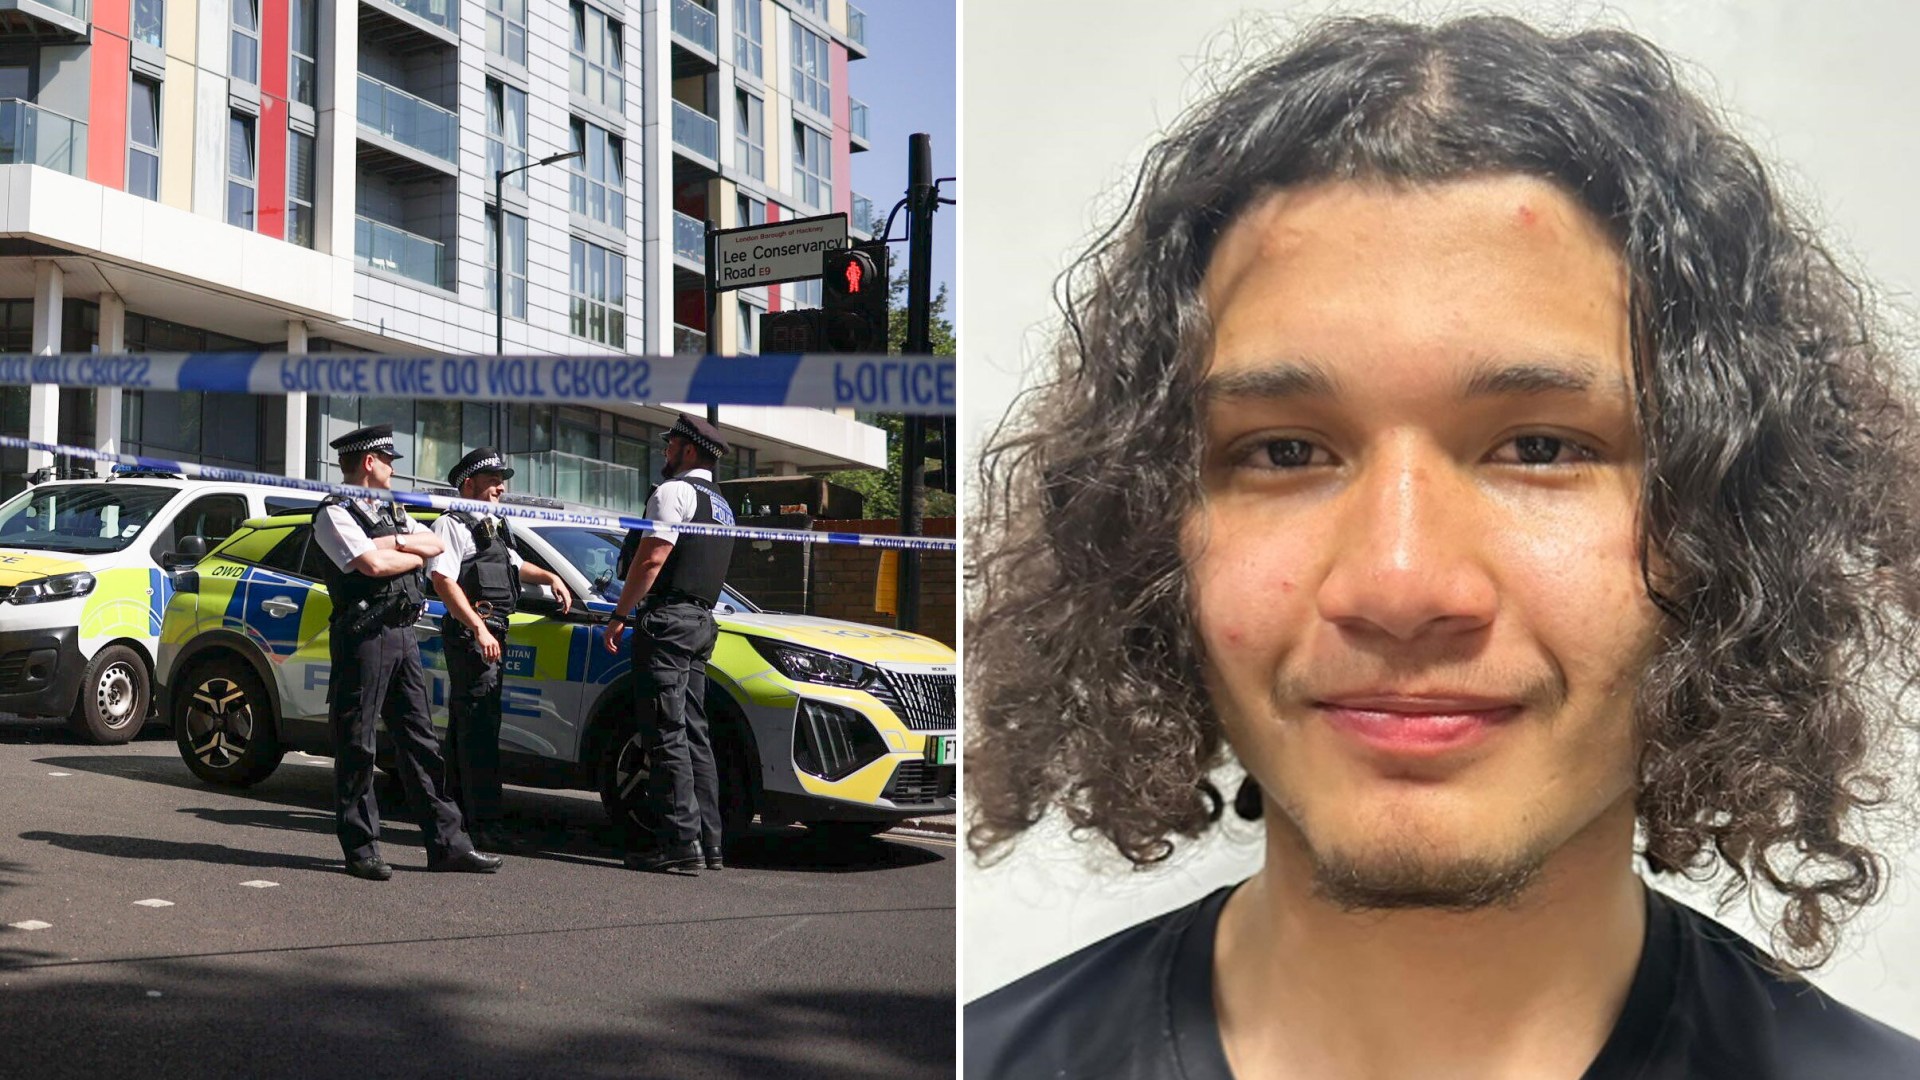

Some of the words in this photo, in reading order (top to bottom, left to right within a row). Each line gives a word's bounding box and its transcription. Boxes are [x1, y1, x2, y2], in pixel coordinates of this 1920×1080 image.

[735, 234, 759, 243] London
[760, 231, 787, 240] Borough
[796, 226, 824, 235] Hackney
[723, 250, 747, 264] Lee
[752, 237, 843, 260] Conservancy
[723, 264, 756, 280] Road
[758, 267, 771, 276] E9
[211, 565, 245, 578] QWD
